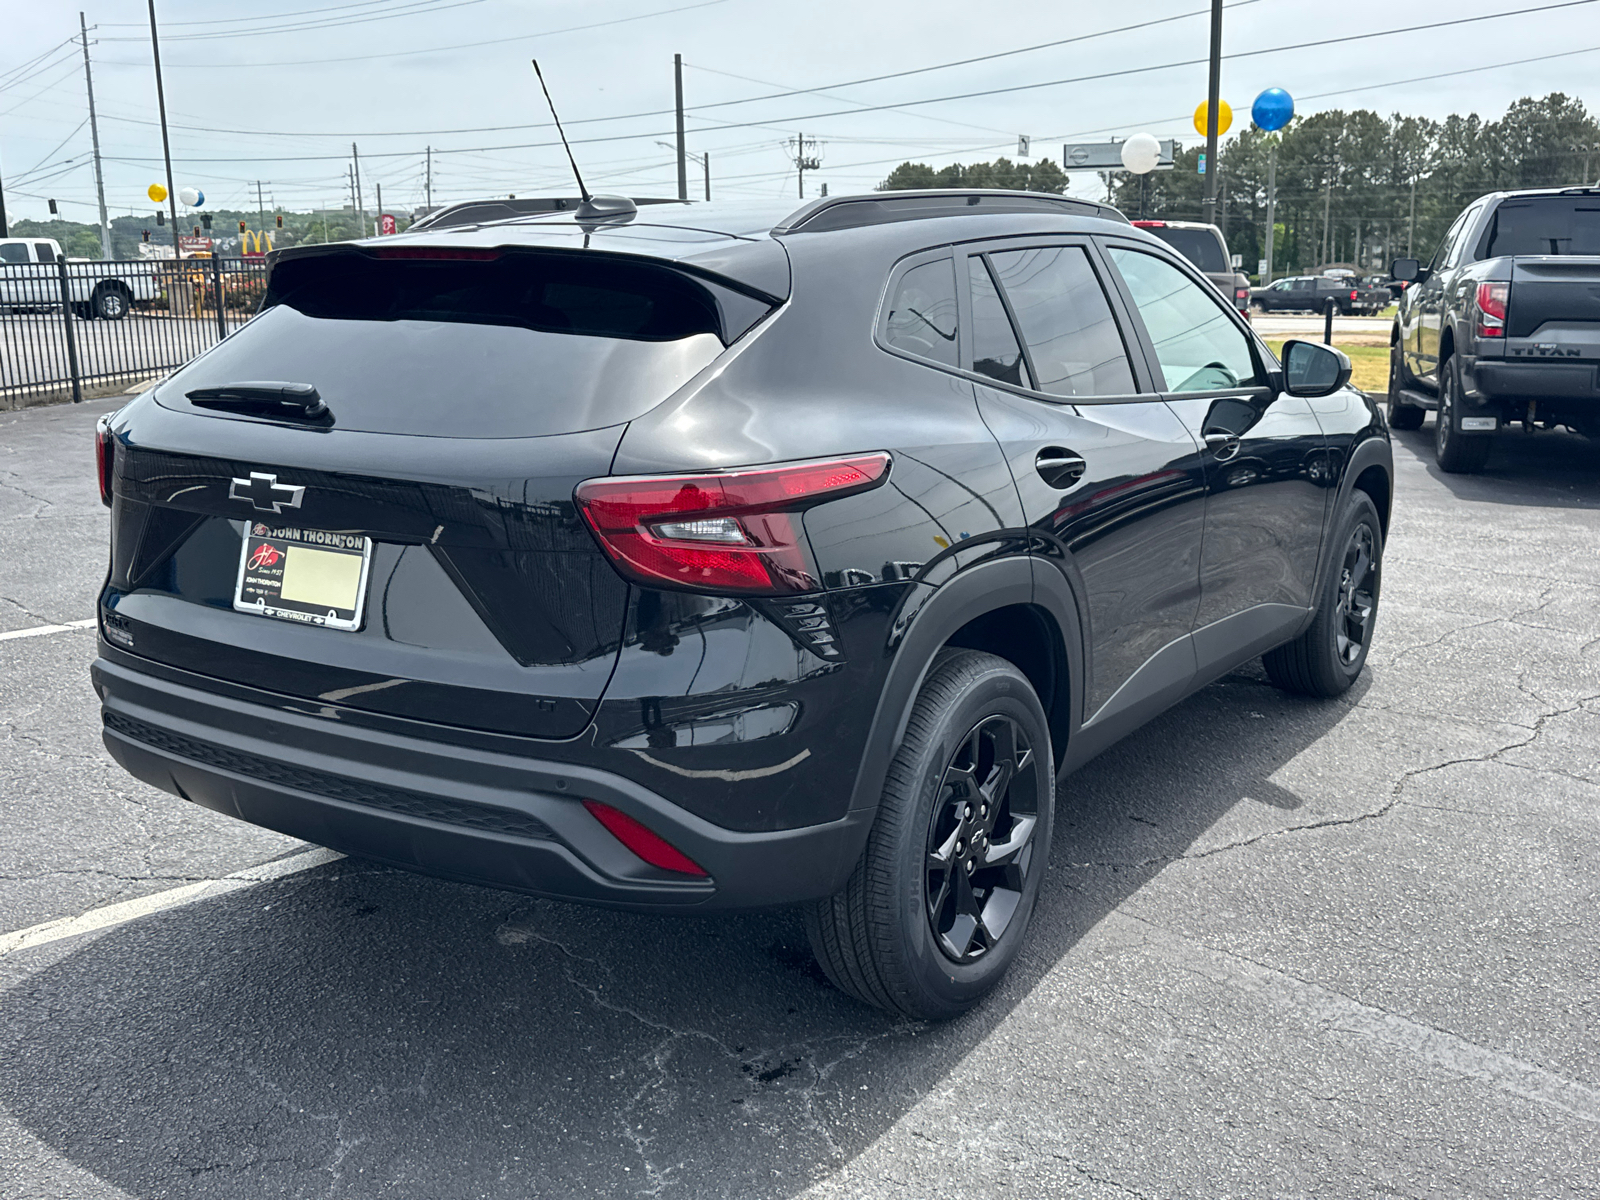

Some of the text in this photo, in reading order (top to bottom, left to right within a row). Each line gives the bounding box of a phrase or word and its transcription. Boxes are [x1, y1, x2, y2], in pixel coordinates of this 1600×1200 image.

[1511, 348, 1581, 357] TITAN
[272, 528, 300, 541] JOHN
[303, 530, 364, 549] THORNTON
[258, 566, 270, 575] Since
[246, 576, 281, 588] JOHN THORNTON
[276, 610, 313, 623] CHEVROLET
